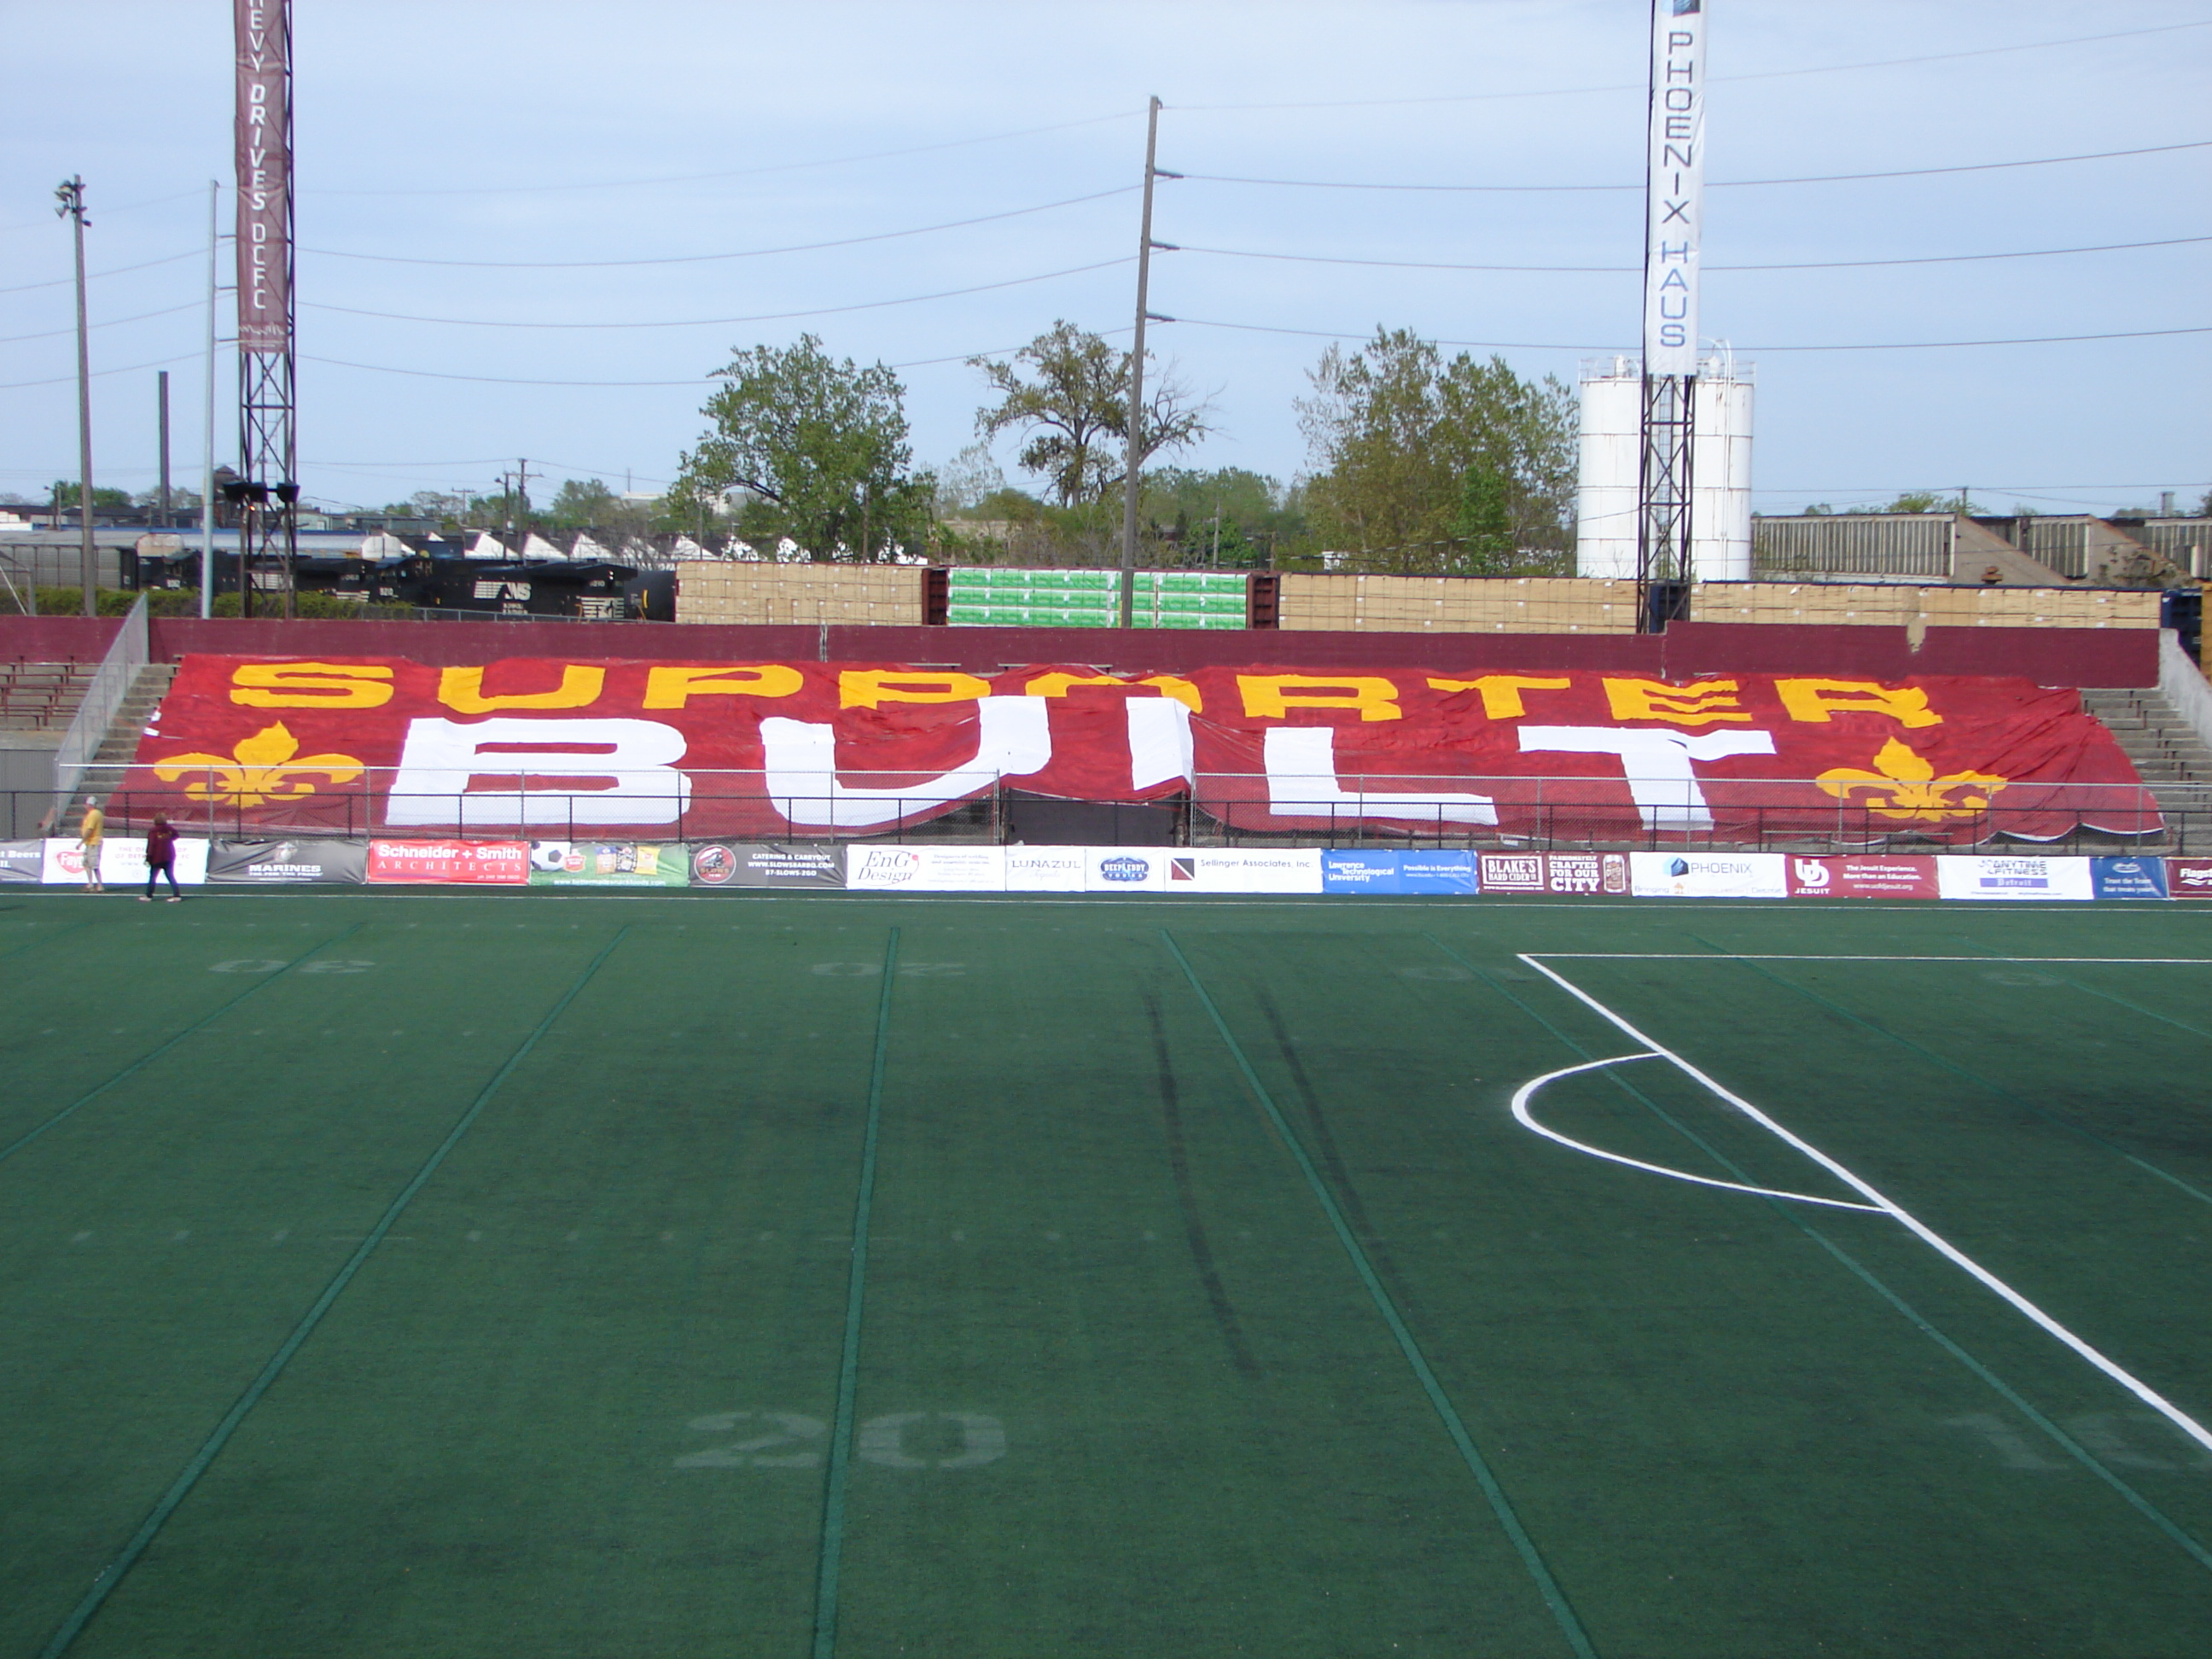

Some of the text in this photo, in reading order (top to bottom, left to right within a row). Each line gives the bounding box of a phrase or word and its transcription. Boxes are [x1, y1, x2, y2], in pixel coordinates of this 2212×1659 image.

[249, 85, 265, 210] DRIVES
[1659, 32, 1693, 347] PHOENIX HAUS
[252, 224, 266, 309] DCFC
[384, 696, 1777, 830] BUILT
[378, 844, 521, 860] Schneider + Smith
[377, 860, 521, 871] ARCHITECTS
[865, 851, 911, 868] EnG
[1201, 859, 1239, 868] Sellinger
[1296, 859, 1313, 868] Inc.
[1487, 860, 1536, 873] BLAKE'S
[1549, 861, 1598, 870] CRAFTED
[1342, 868, 1394, 876] Technological
[1574, 870, 1599, 878] OUR
[1691, 862, 1752, 874] PHOENIX
[858, 867, 913, 884] Design
[1329, 874, 1371, 882] University
[1509, 873, 1530, 882] CIDER
[1551, 877, 1600, 892] CITY
[673, 1411, 1005, 1469] 20
